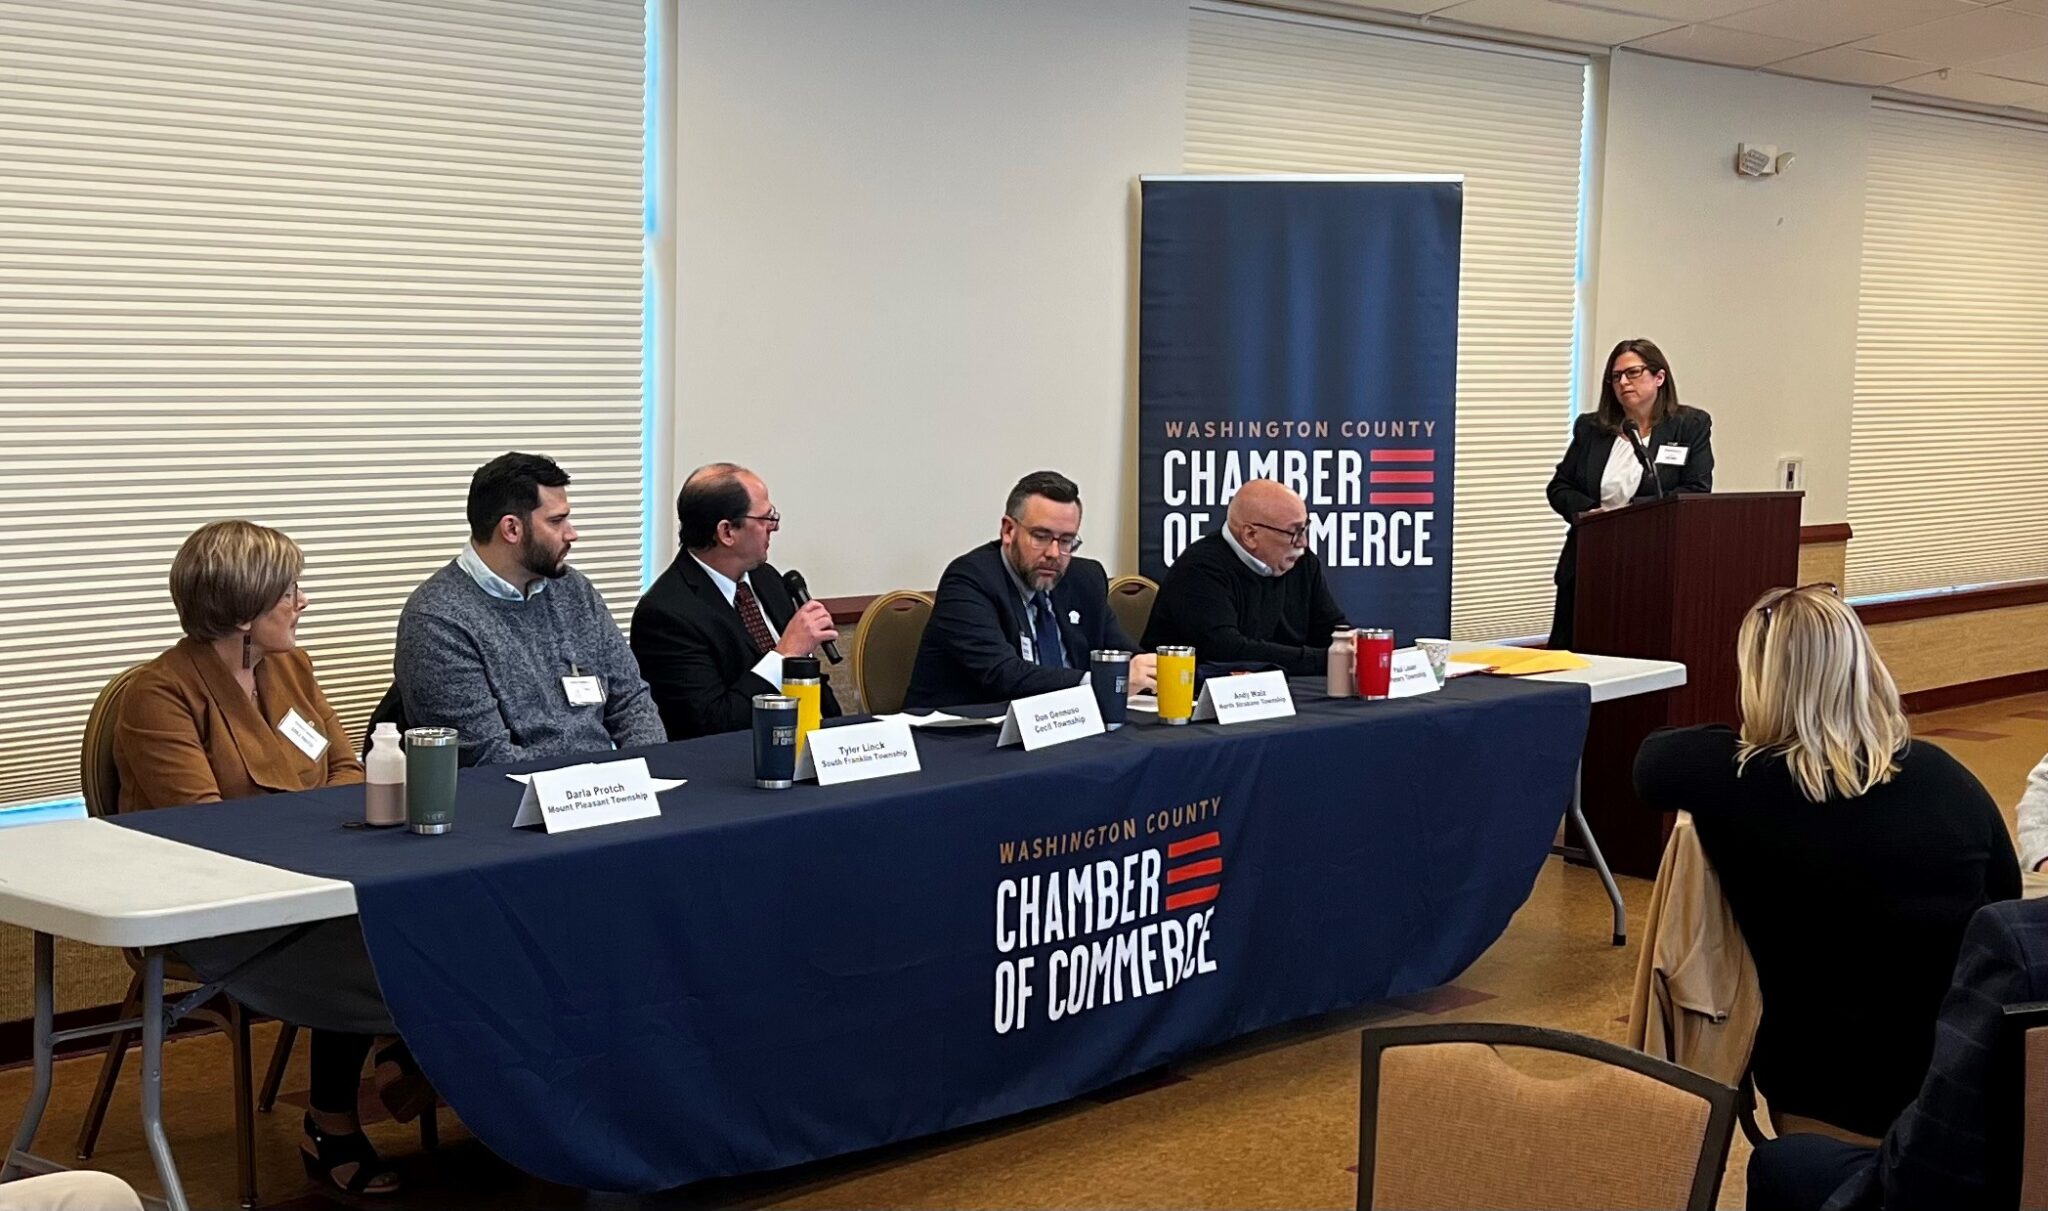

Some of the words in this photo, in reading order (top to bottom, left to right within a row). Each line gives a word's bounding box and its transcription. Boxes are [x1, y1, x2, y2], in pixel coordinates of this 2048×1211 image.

[1165, 420, 1329, 438] WASHINGTON
[1341, 420, 1437, 438] COUNTY
[1053, 716, 1086, 728] Township
[821, 759, 843, 768] South
[874, 749, 908, 760] Township
[838, 746, 860, 756] Tyler
[566, 788, 592, 800] Darla
[593, 783, 625, 796] Protch
[547, 803, 574, 814] Mount
[575, 798, 611, 810] Pleasant
[611, 792, 649, 804] Township
[1000, 818, 1137, 864] WASHINGTON
[1146, 796, 1222, 834] COUNTY
[996, 848, 1162, 953] CHAMBER
[994, 956, 1036, 1034] OF
[1047, 905, 1218, 1022] COMMERCE
